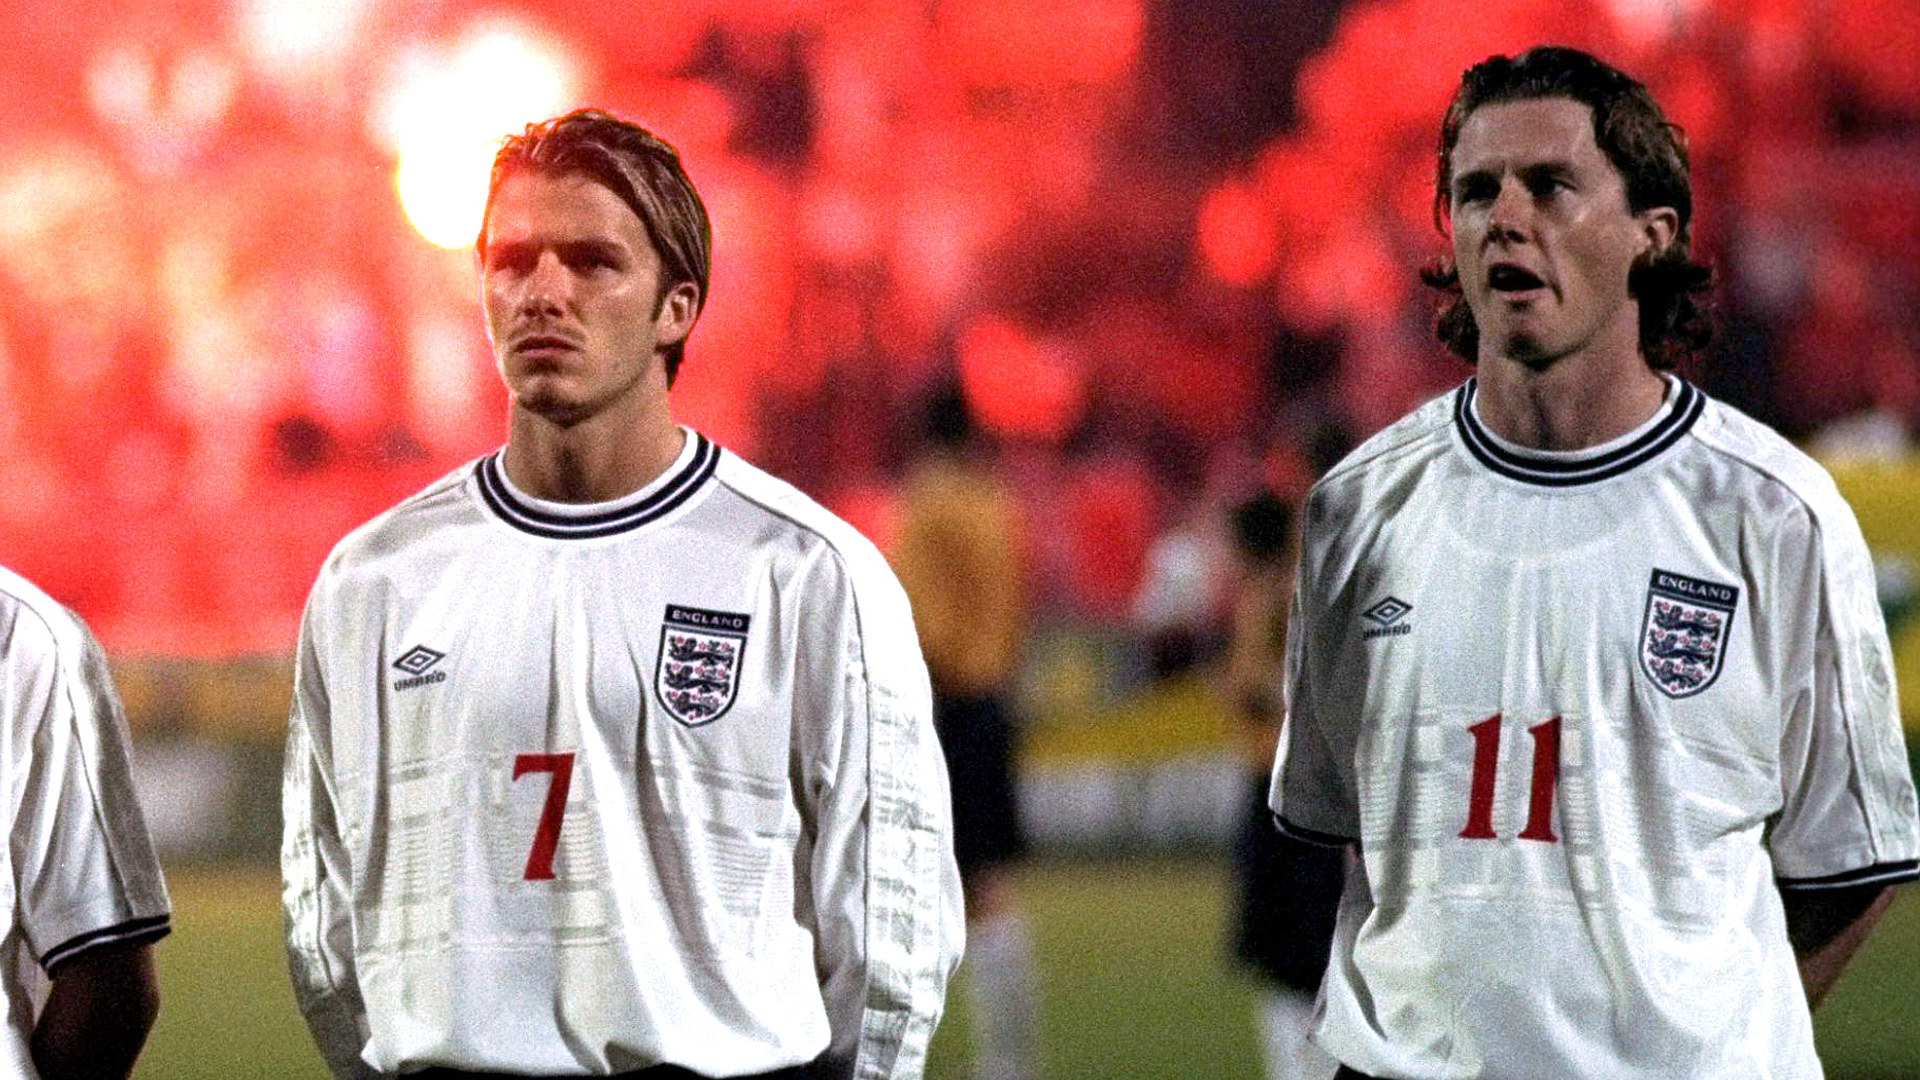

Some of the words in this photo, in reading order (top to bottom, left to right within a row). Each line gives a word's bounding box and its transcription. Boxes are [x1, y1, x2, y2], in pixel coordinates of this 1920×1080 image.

[672, 609, 743, 628] ENGLAND
[1659, 575, 1732, 600] ENGLAND
[1458, 711, 1562, 842] 11
[512, 753, 575, 880] 7
